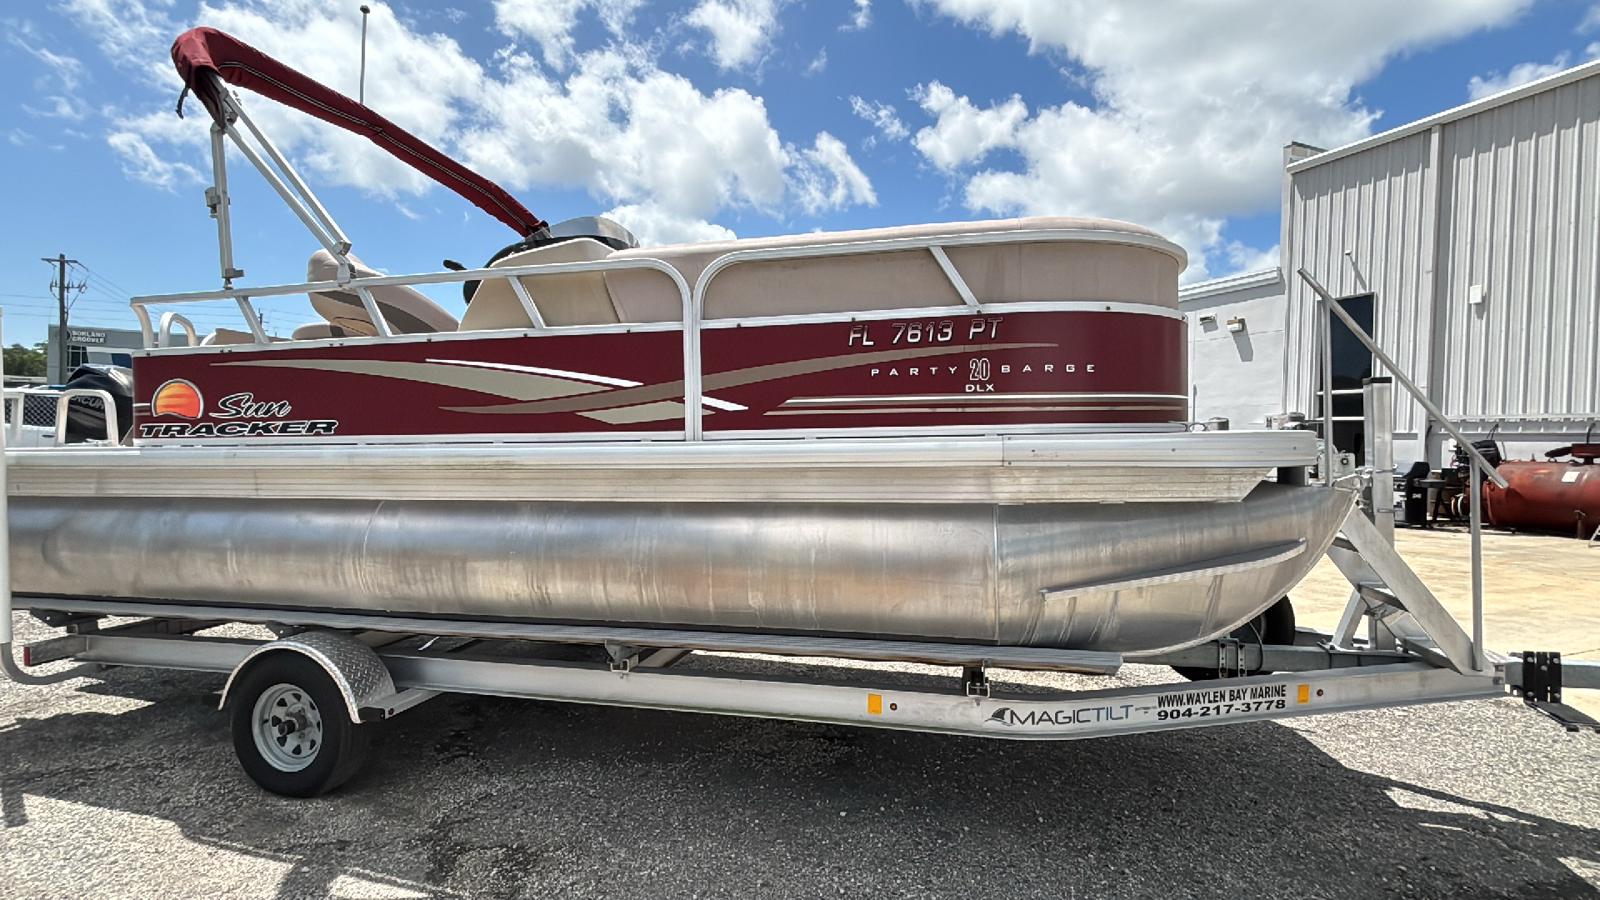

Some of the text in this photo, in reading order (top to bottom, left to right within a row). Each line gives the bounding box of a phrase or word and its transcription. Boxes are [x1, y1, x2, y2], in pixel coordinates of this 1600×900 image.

[72, 330, 106, 338] BORLAND
[848, 317, 1004, 346] FL 7613 PT
[871, 358, 1096, 381] PARTY 20 BARGE
[965, 383, 995, 392] DLX
[209, 392, 292, 418] Sun
[140, 420, 338, 437] TRACKER
[1158, 685, 1287, 708] WWW.WAYLEN BAY MARINE
[1010, 704, 1134, 726] MAGICTILT
[1157, 699, 1286, 720] 904-217-3778
